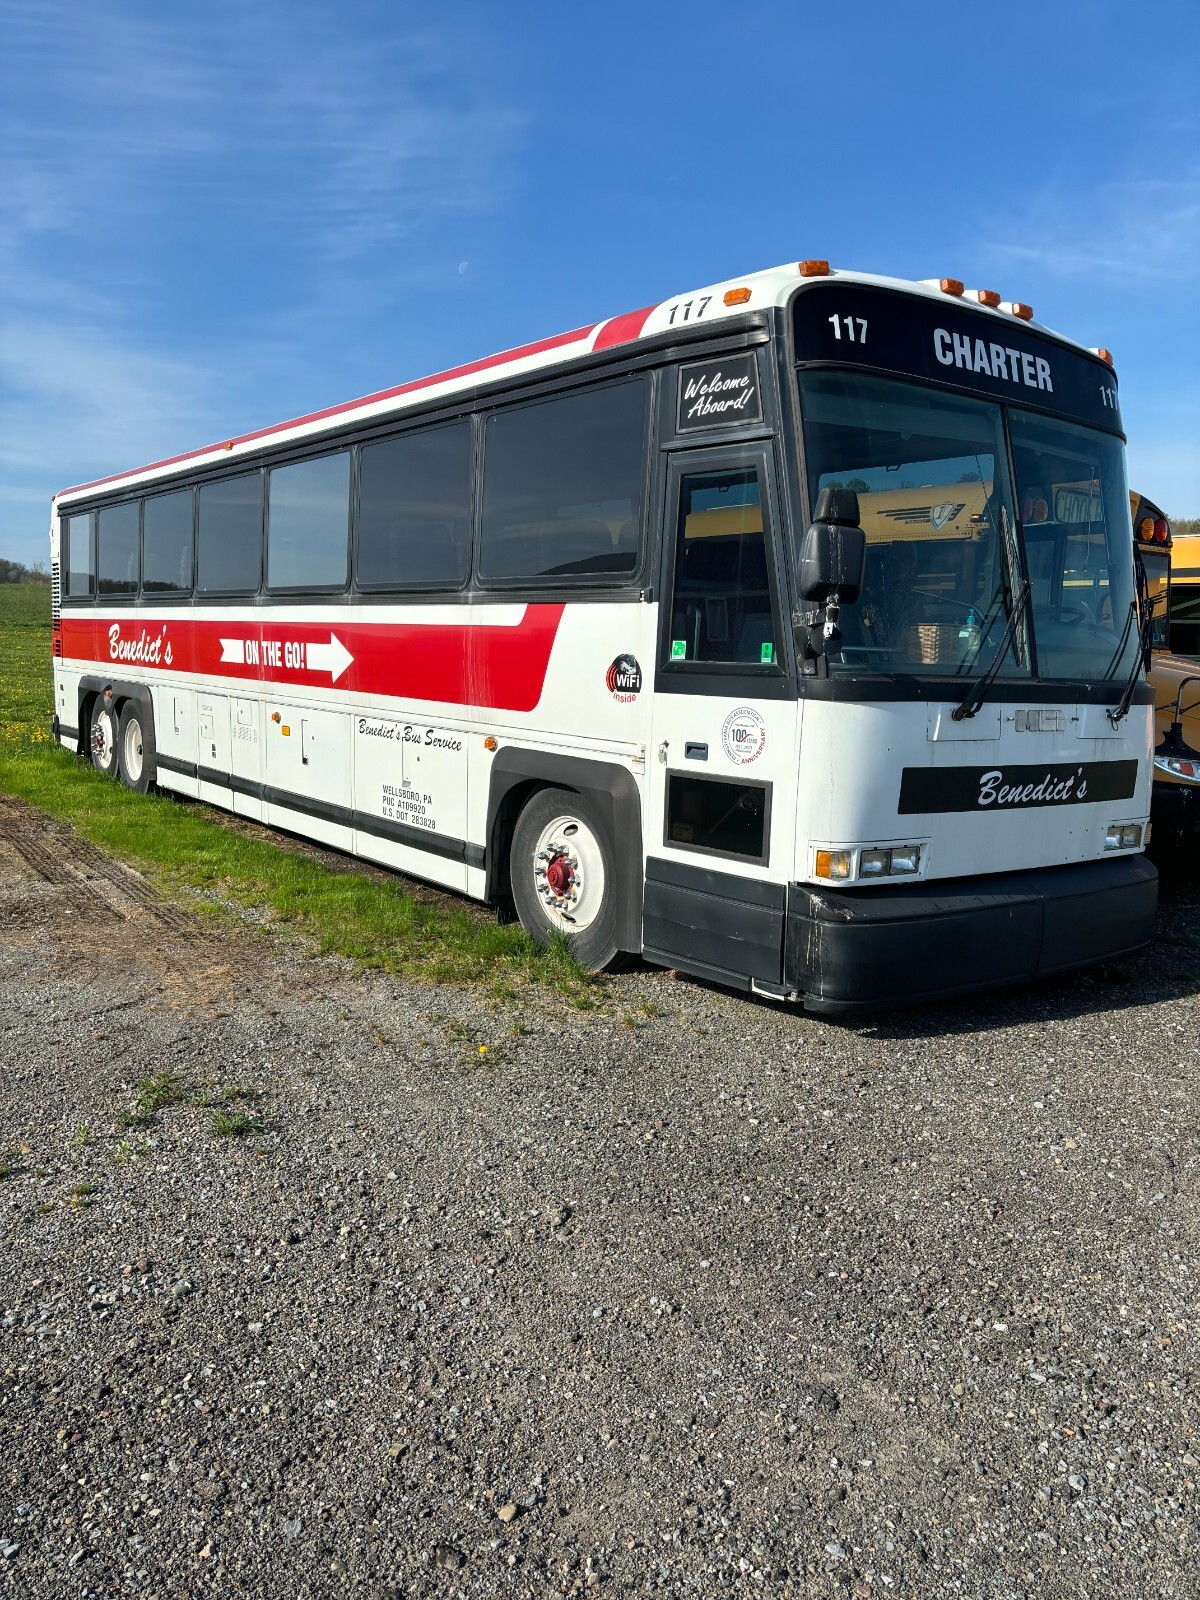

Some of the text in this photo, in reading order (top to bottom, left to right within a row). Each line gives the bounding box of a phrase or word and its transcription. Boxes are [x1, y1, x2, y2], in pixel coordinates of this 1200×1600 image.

[669, 296, 712, 325] 117
[828, 313, 868, 344] 117
[933, 328, 1054, 393] CHARTER
[684, 372, 750, 400] Welcome
[687, 386, 755, 419] Aboard!
[108, 623, 173, 665] Benedict's
[245, 639, 305, 669] ON THE GO!
[616, 674, 640, 688] WiFi
[613, 690, 637, 703] inside
[359, 718, 462, 751] Benedict's Bus Service
[732, 728, 747, 742] 100
[741, 727, 766, 764] ANNIVERSARY
[382, 784, 433, 805] WELLSBORO, PA
[977, 767, 1088, 805] Benedict's
[382, 795, 426, 815] PUC A109920
[382, 806, 395, 818] U.S.
[396, 810, 408, 822] DOT
